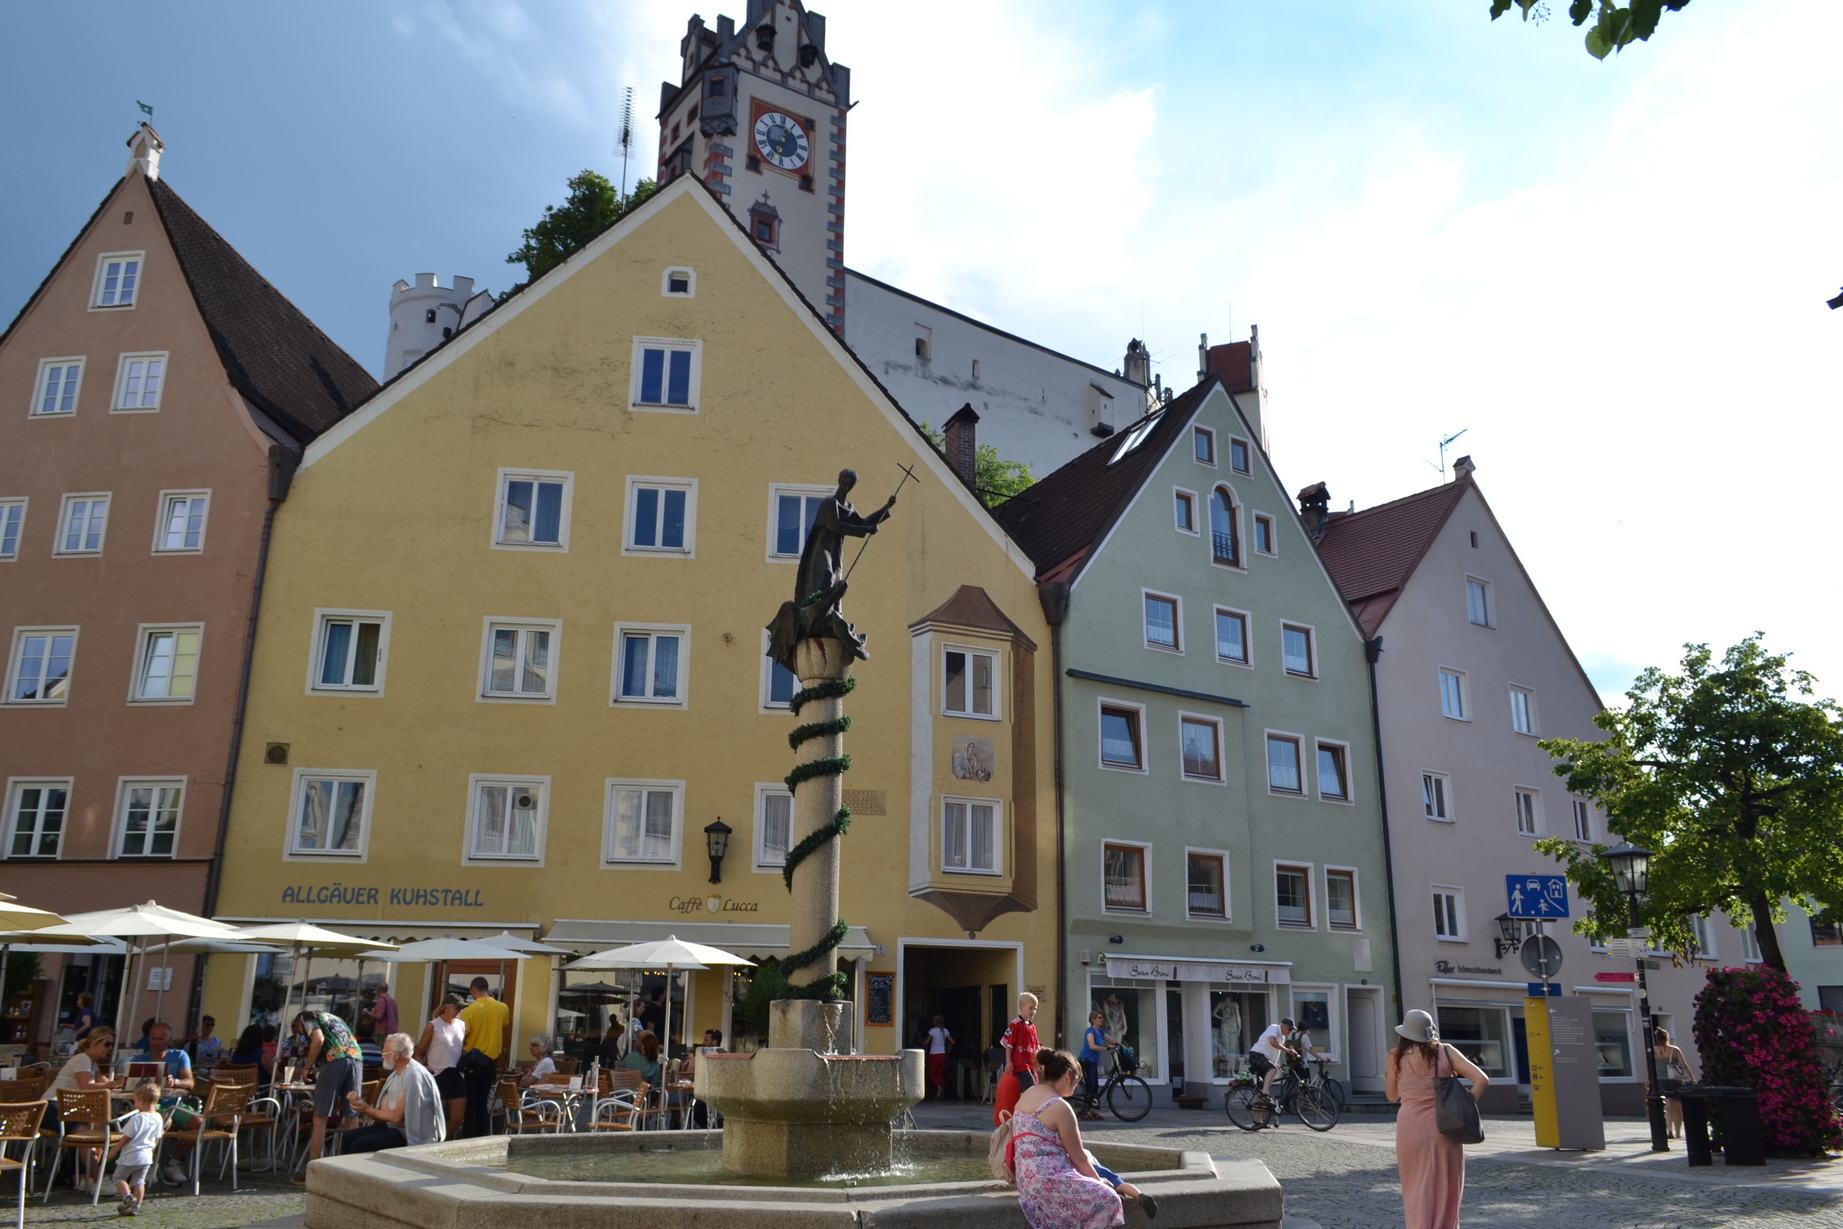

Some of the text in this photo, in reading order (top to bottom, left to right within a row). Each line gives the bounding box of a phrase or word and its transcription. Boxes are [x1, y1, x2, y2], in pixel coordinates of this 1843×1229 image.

[281, 882, 484, 907] ALLGÄUER KUHSTALL
[722, 899, 758, 912] Lucca
[1457, 965, 1502, 975] Schmuckhandwerk
